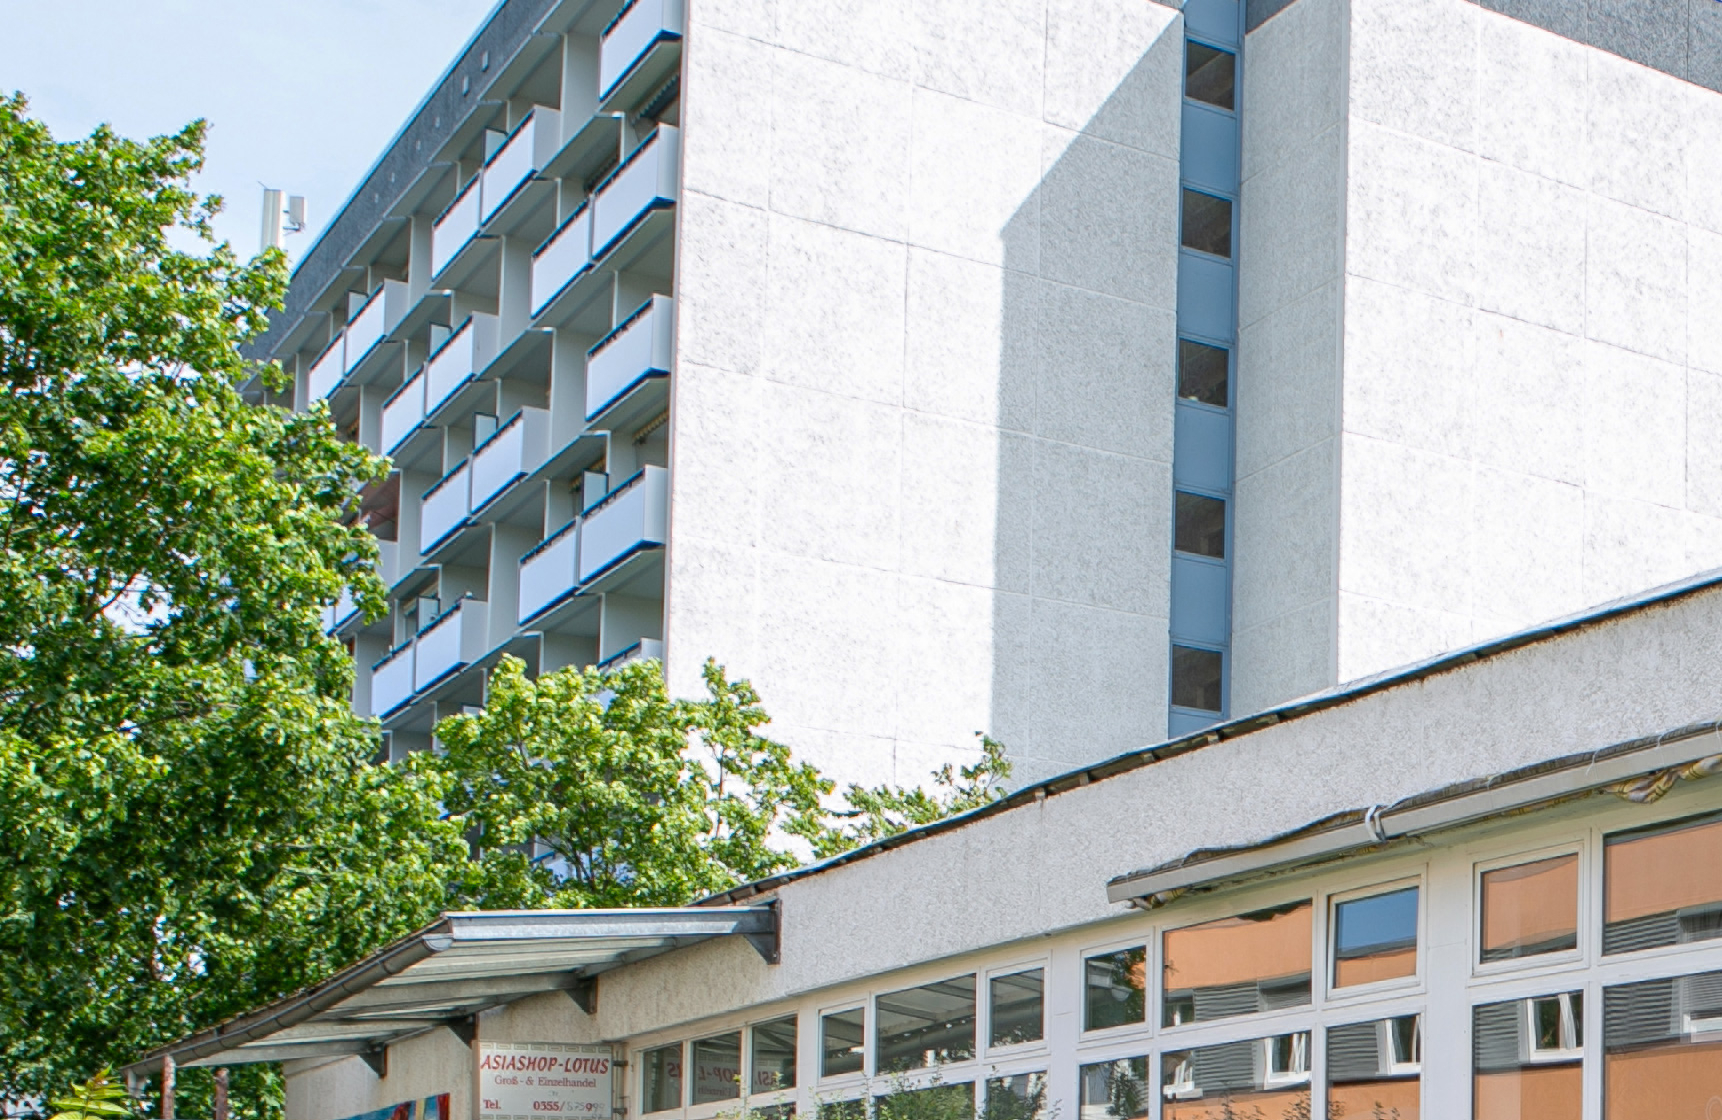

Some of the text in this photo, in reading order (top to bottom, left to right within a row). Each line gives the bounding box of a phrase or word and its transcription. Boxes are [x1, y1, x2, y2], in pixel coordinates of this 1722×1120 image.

[480, 1054, 610, 1075] ASIASHOP-LOTUS
[525, 1077, 535, 1086] &
[538, 1077, 597, 1088] Einzelhandel
[483, 1099, 502, 1110] Tel.
